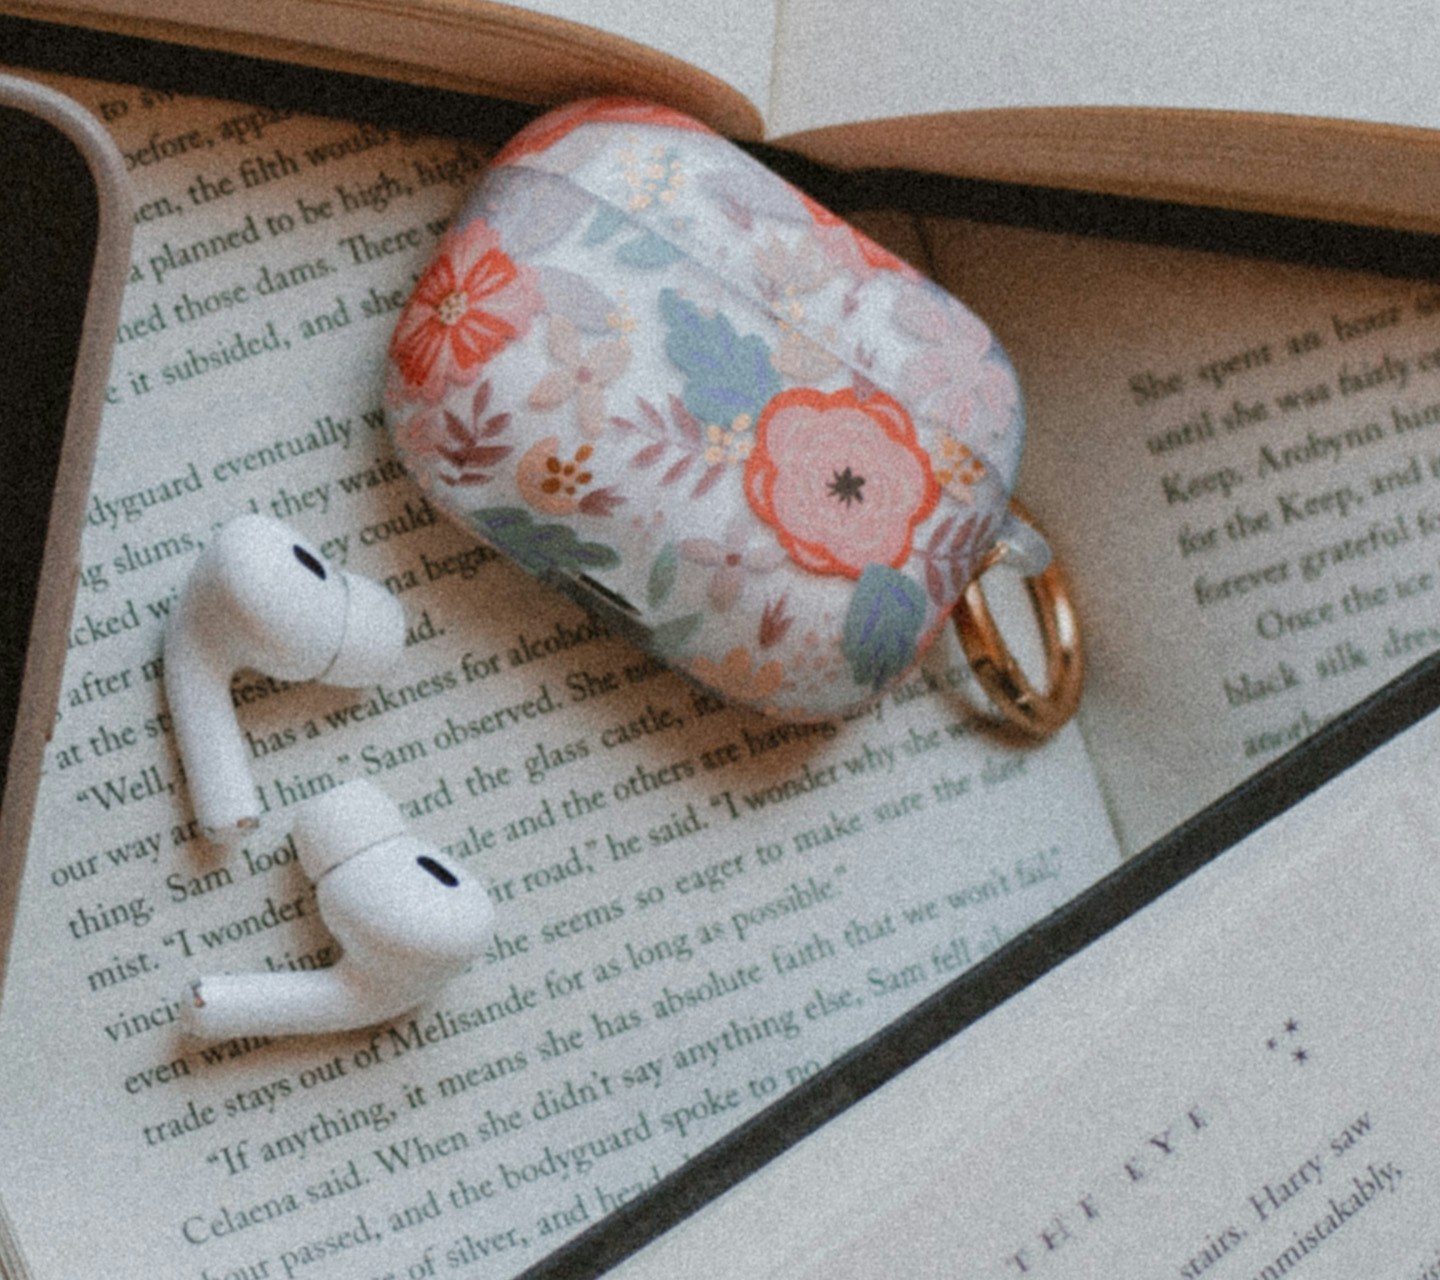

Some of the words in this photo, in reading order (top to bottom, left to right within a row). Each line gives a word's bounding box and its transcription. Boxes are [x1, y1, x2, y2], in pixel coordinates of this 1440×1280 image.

[126, 370, 153, 398] it
[159, 319, 292, 387] subsided,
[298, 295, 353, 340] and
[359, 286, 413, 319] she
[1126, 370, 1185, 408] She
[1194, 342, 1274, 390] spent
[1283, 329, 1325, 359] an
[1190, 559, 1291, 609] forever
[1298, 513, 1412, 582] grateful
[203, 1137, 250, 1178] “If
[258, 1100, 399, 1164] anything,
[400, 1082, 429, 1111] it
[434, 1050, 529, 1100] means
[535, 1027, 584, 1062] she
[588, 1008, 644, 1042] has
[651, 963, 763, 1021] absolute
[769, 932, 837, 977] faith
[841, 912, 897, 950] that
[900, 898, 940, 927] we
[1246, 1153, 1323, 1223] Harry
[1327, 1111, 1374, 1158] saw
